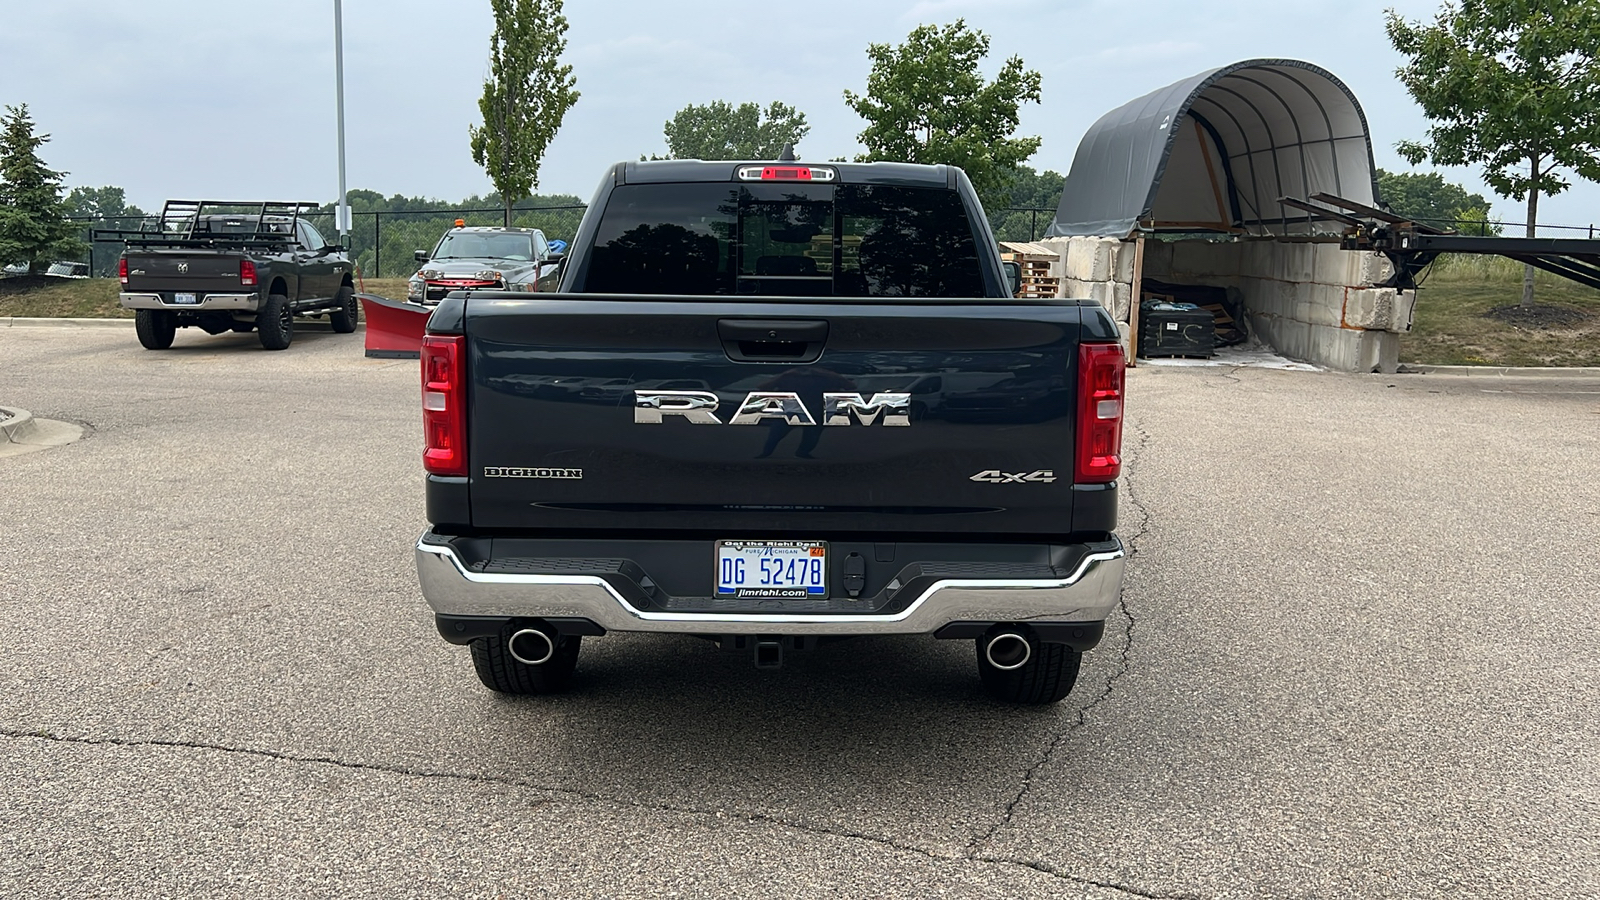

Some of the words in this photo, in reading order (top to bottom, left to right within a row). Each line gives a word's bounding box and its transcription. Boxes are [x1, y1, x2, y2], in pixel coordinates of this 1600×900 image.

[634, 389, 911, 426] RAM
[484, 466, 583, 479] BIGHORN
[969, 469, 1057, 483] 4x4
[722, 558, 745, 584] DG
[760, 558, 821, 585] 52478
[738, 589, 805, 597] jimriehl.com
